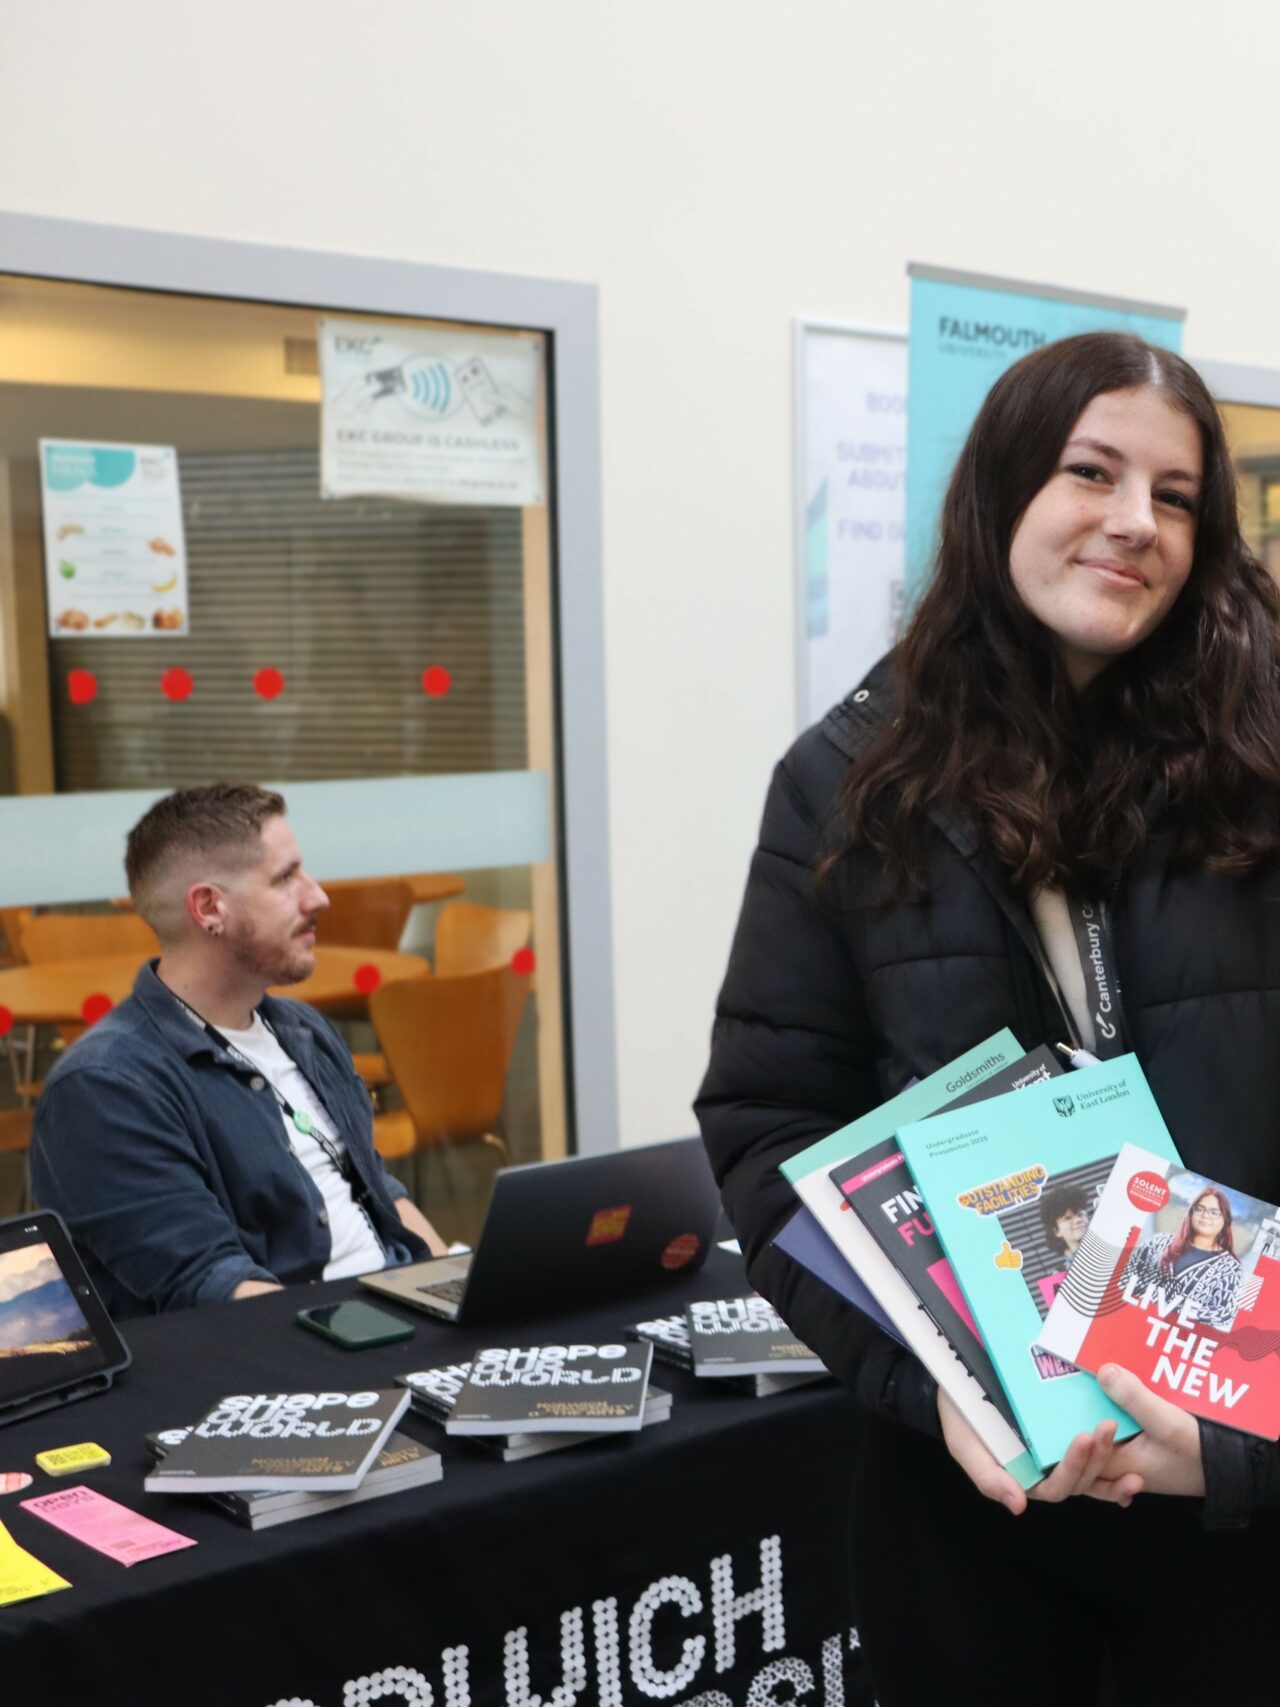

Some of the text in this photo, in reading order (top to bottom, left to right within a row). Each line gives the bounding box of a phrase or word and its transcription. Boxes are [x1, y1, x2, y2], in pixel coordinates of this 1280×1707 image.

[939, 316, 1045, 348] FALMOUTH
[1086, 922, 1112, 1013] Canterbury
[946, 1052, 1006, 1093] Goldsmiths
[1012, 1066, 1039, 1089] University
[1076, 1080, 1127, 1102] University of
[1079, 1089, 1130, 1110] East London
[926, 1129, 979, 1150] Undergraduate
[929, 1141, 970, 1158] Prospectus
[959, 1166, 1045, 1206] OUTSTANDING
[1134, 1176, 1167, 1196] SOLENT
[975, 1182, 1041, 1214] FACILITIES
[1122, 1274, 1201, 1329] LIVE
[1146, 1316, 1219, 1368] THE
[470, 1367, 643, 1387] WORLD
[475, 1358, 565, 1374] OUR
[1151, 1355, 1250, 1408] NEW
[206, 1408, 306, 1426] OUR
[195, 1418, 382, 1439] WORLD
